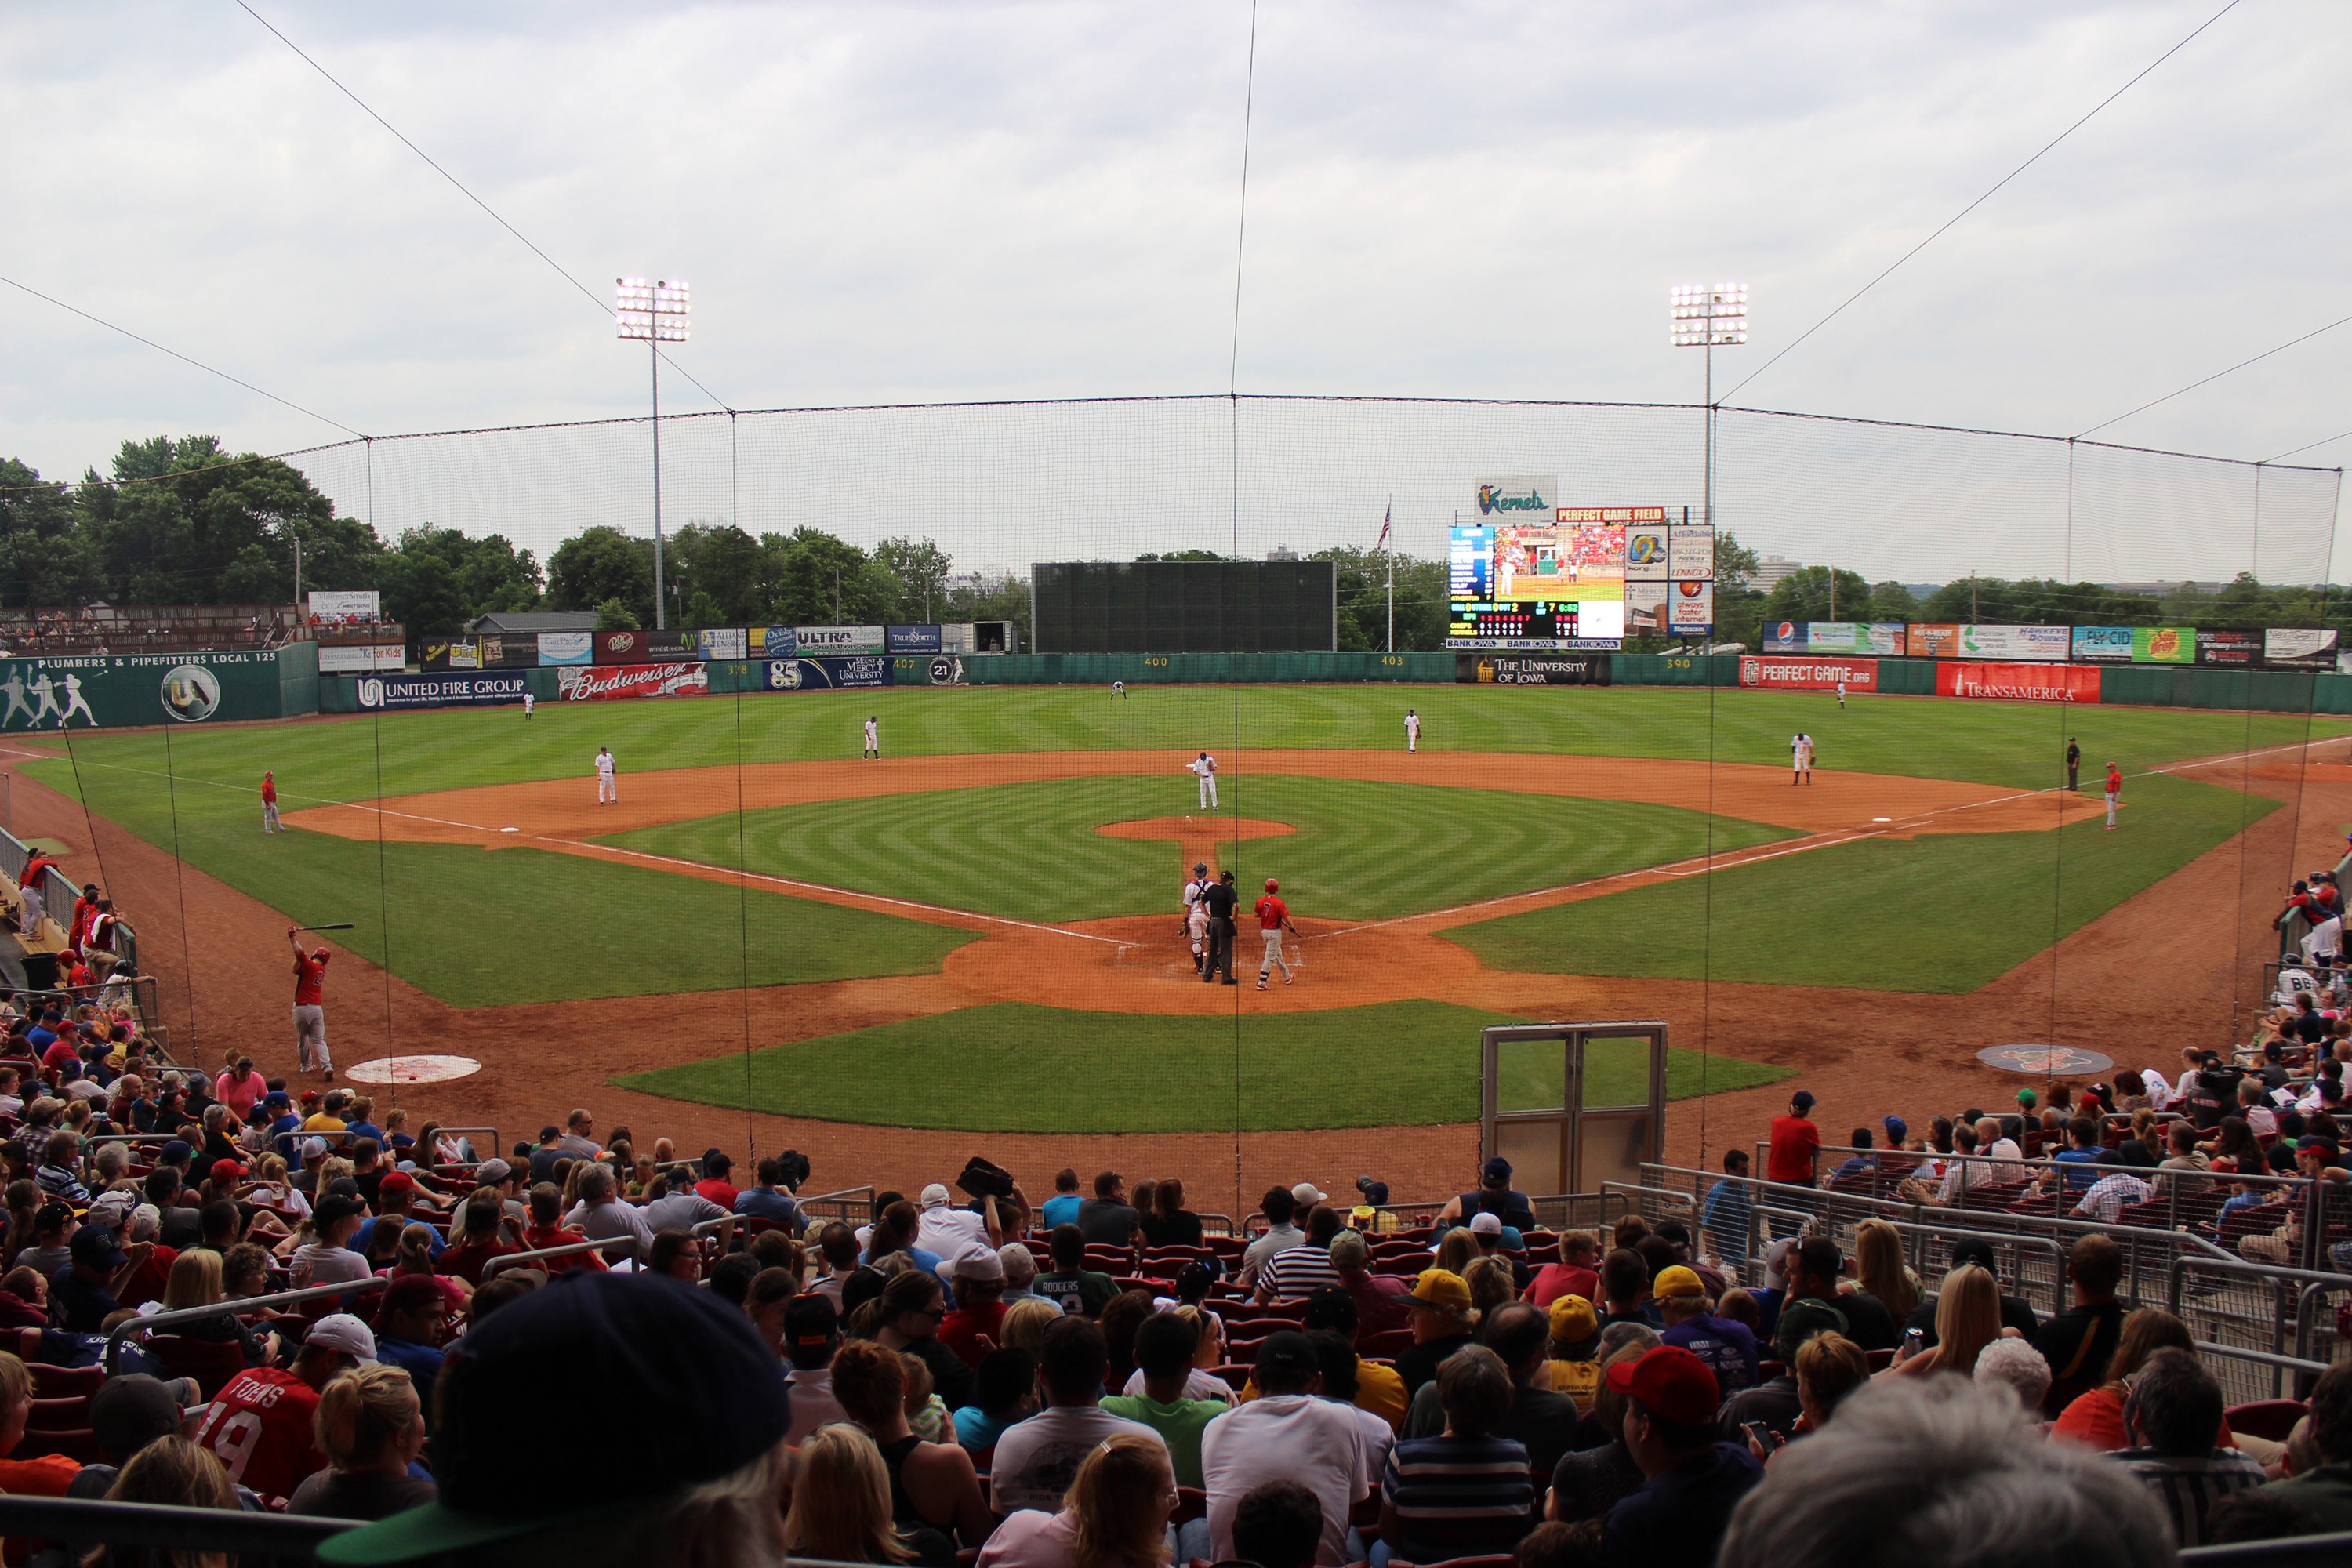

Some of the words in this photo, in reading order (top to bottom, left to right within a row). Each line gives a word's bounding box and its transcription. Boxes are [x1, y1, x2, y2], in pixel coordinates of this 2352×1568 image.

[1479, 485, 1549, 515] Kernels
[1559, 510, 1602, 521] PERFECT
[1603, 509, 1632, 521] GAME
[1634, 508, 1663, 521] FIELD
[1671, 568, 1703, 577] LENNOX
[1512, 603, 1519, 612] 2
[1548, 603, 1556, 612] 7
[717, 631, 746, 640] ALLIANT
[797, 632, 852, 644] ULTRA
[717, 639, 746, 648] ENERGY
[39, 659, 106, 668] PLUMBERS
[115, 658, 124, 666] &
[132, 655, 206, 666] PIPEFITTERS
[213, 654, 249, 663] LOCAL
[256, 652, 275, 662] 125
[894, 659, 915, 669] 407
[1144, 657, 1168, 667] 400
[1381, 656, 1404, 666] 403
[1495, 659, 1519, 672] THE
[1522, 659, 1587, 672] UNIVERSITY
[1668, 659, 1690, 668] 390
[847, 662, 876, 673] MERCY
[934, 666, 948, 675] 21
[1762, 665, 1813, 681] PERFECT
[770, 660, 801, 688] 85
[839, 670, 883, 681] UNIVERSITY
[1517, 672, 1547, 684] IOWA
[386, 682, 439, 697] UNITED
[442, 681, 470, 695] FIRE
[474, 679, 524, 694] GROUP
[569, 663, 687, 701] Budweiser
[1965, 682, 2075, 702] TRANSAMERICA
[1264, 903, 1271, 917] 7
[1043, 1280, 1079, 1292] RODGERS
[229, 1376, 285, 1409] TOEWS
[194, 1401, 263, 1484] 19
